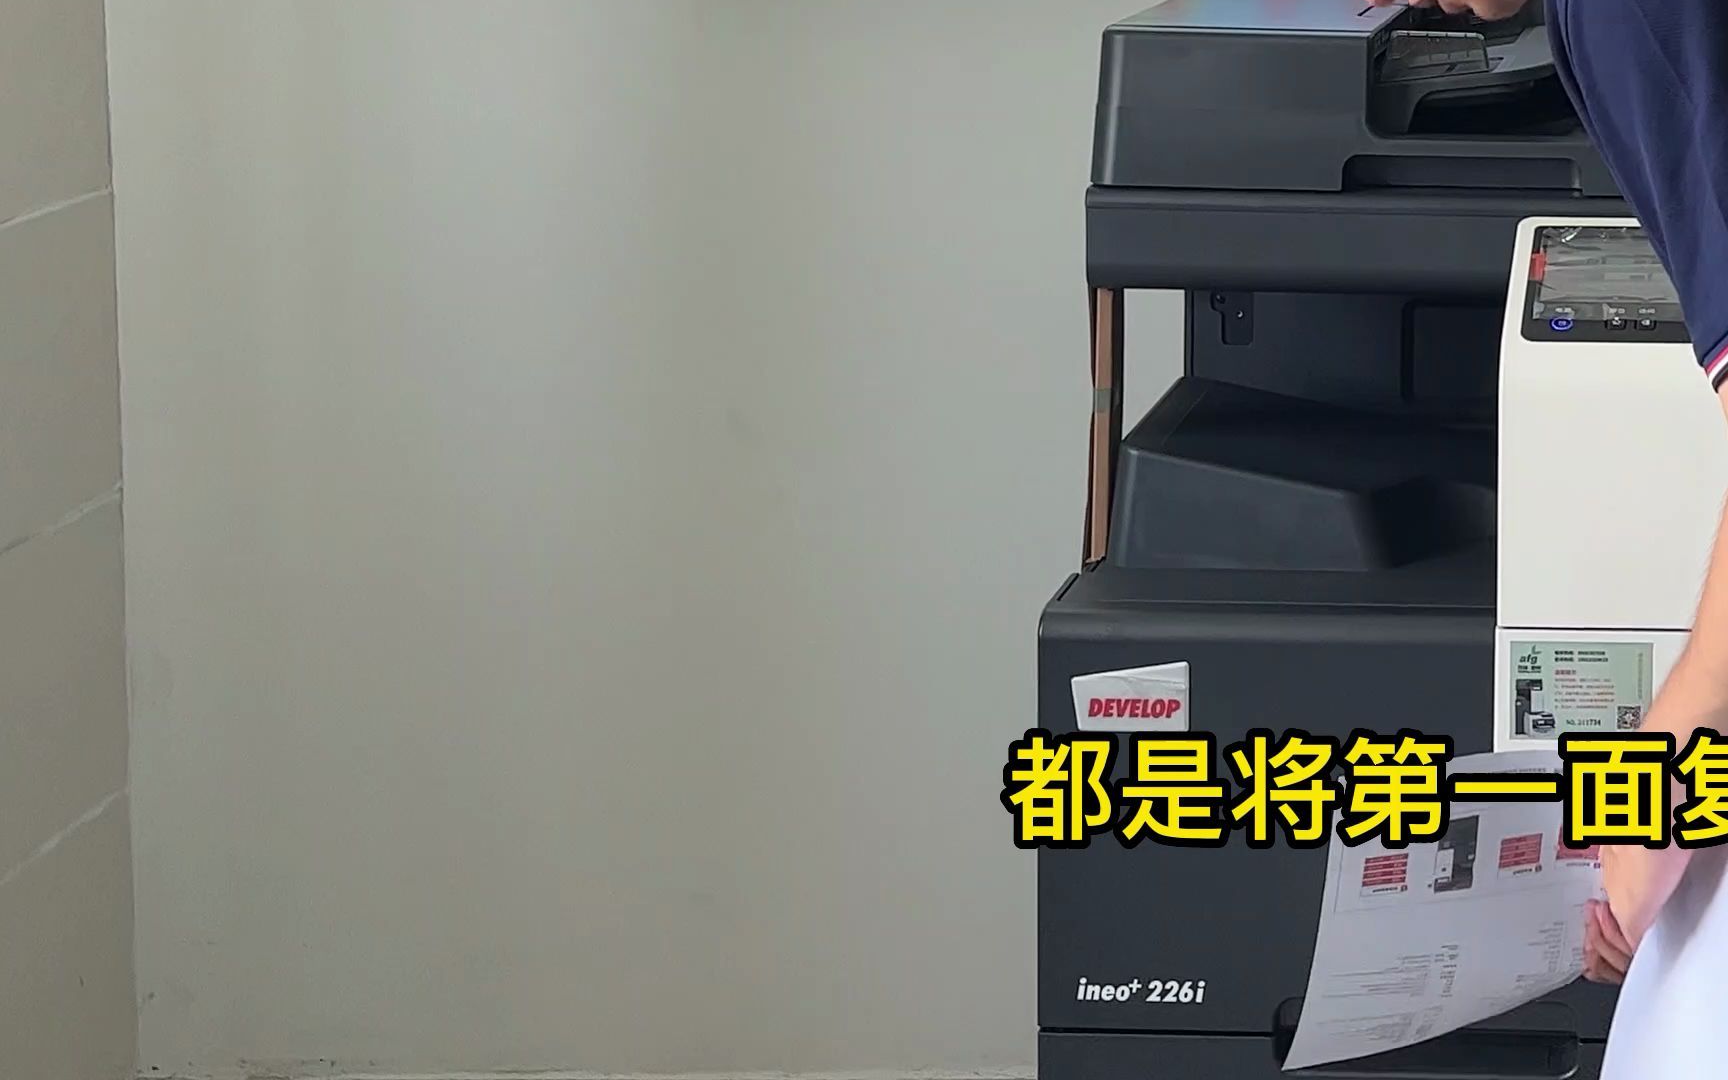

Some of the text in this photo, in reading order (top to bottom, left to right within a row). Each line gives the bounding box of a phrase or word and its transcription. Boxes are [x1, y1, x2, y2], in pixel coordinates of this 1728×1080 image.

[1519, 653, 1538, 665] afg
[1087, 697, 1181, 718] DEVELOP
[1145, 980, 1206, 1003] 226i
